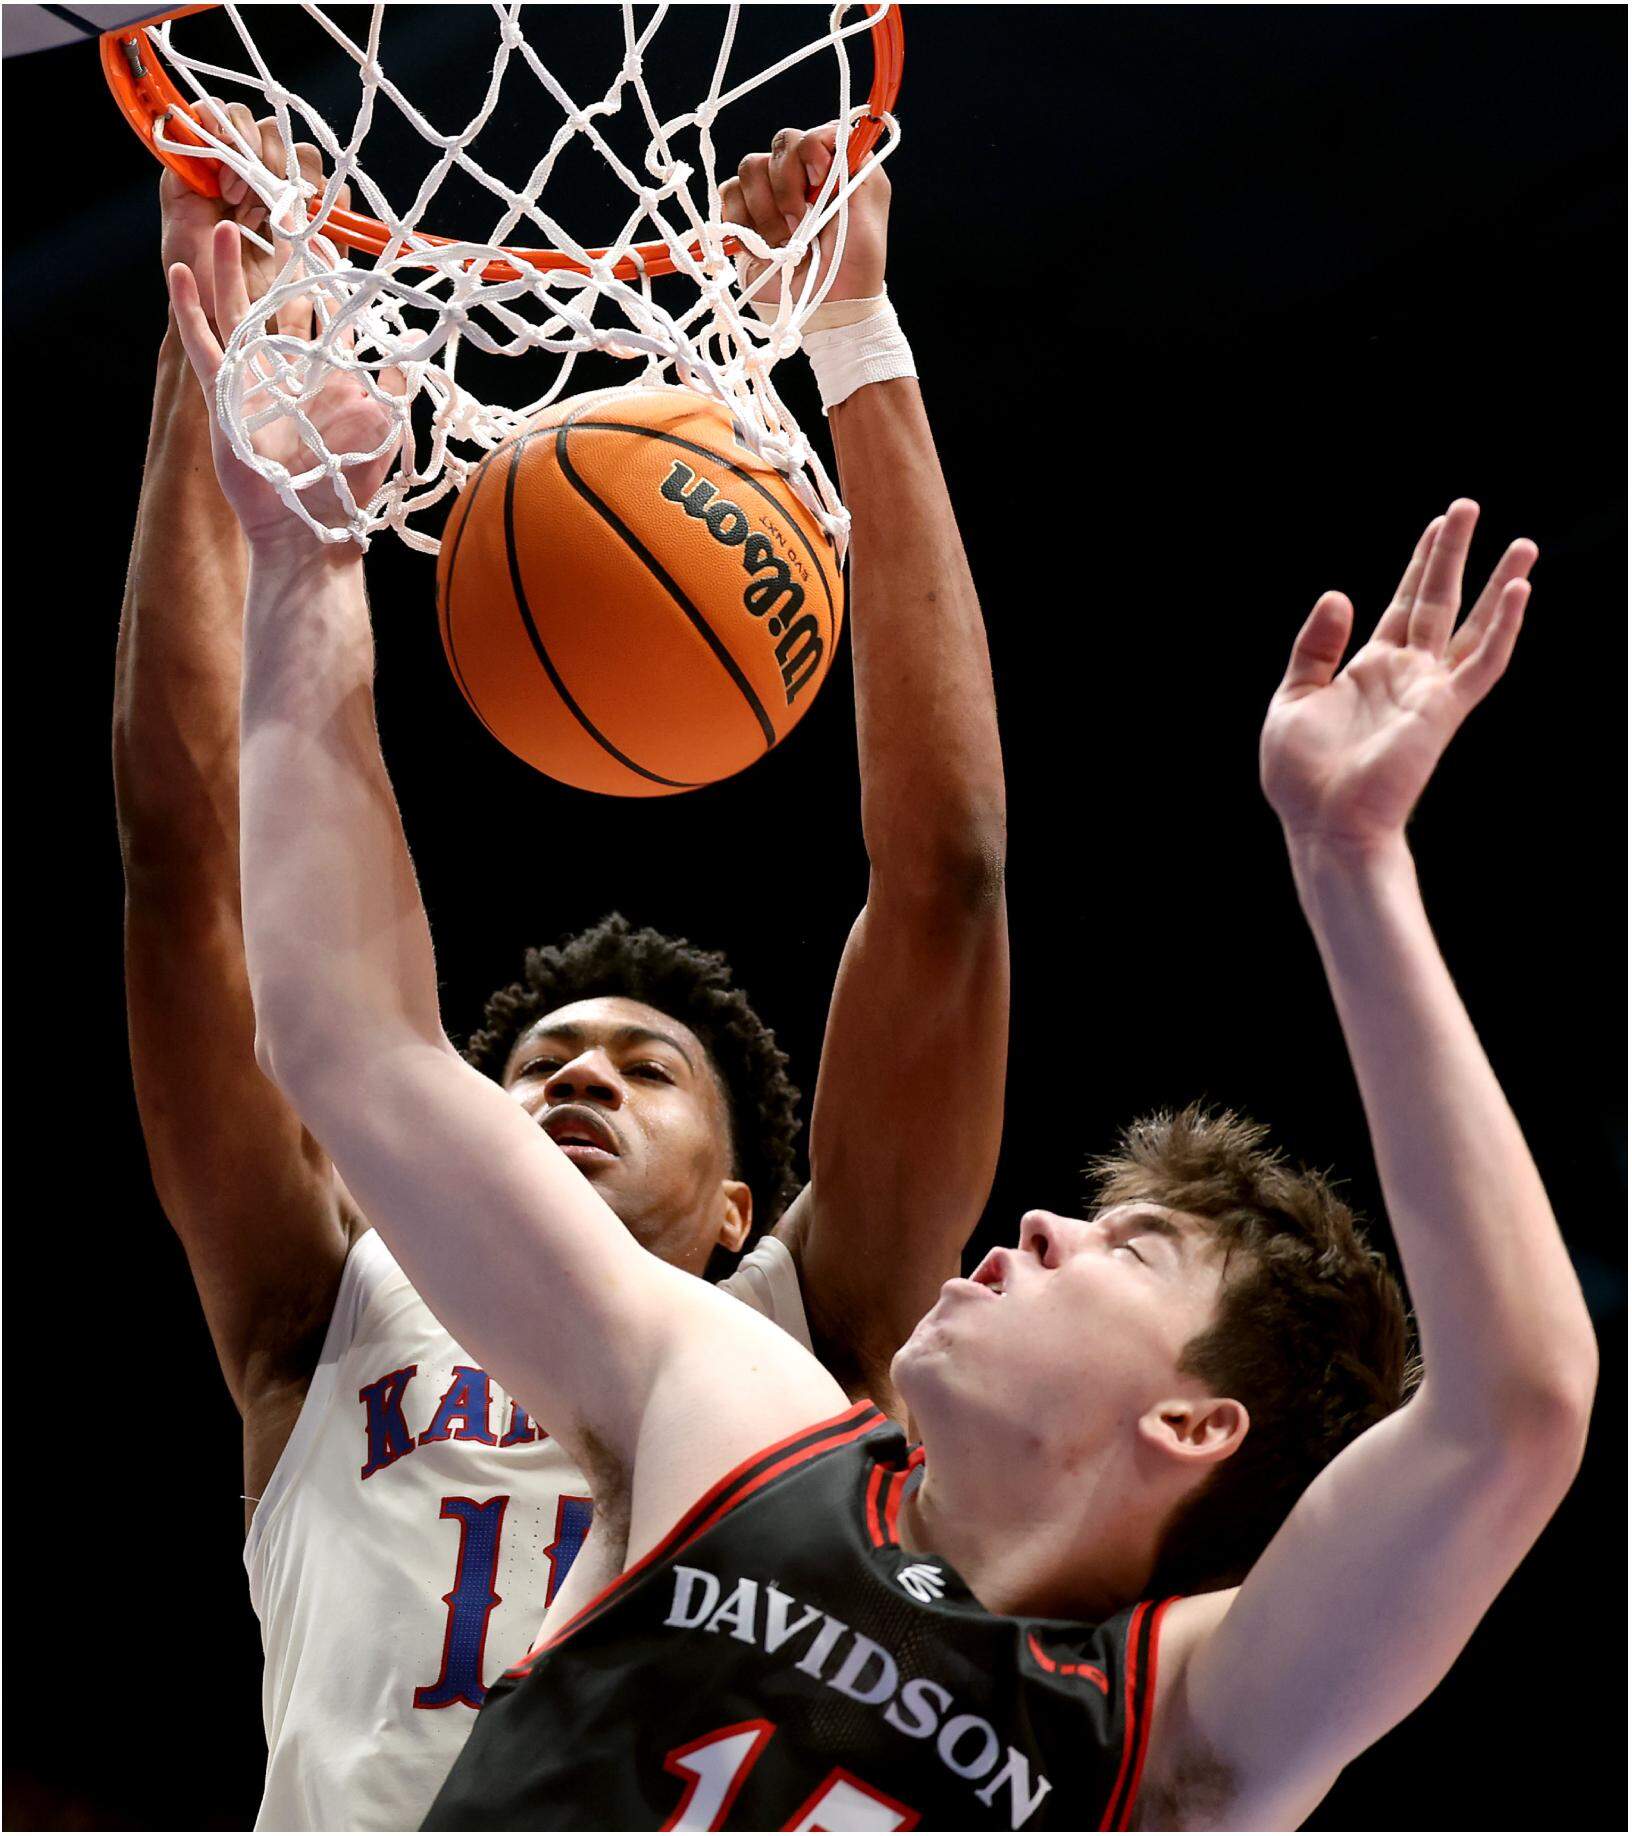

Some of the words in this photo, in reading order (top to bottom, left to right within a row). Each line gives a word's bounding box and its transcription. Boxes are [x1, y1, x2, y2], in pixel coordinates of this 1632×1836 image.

[660, 459, 824, 708] Wilson
[758, 516, 787, 547] NXT
[787, 548, 809, 582] EVO
[663, 1564, 1053, 1831] DAVIDSON
